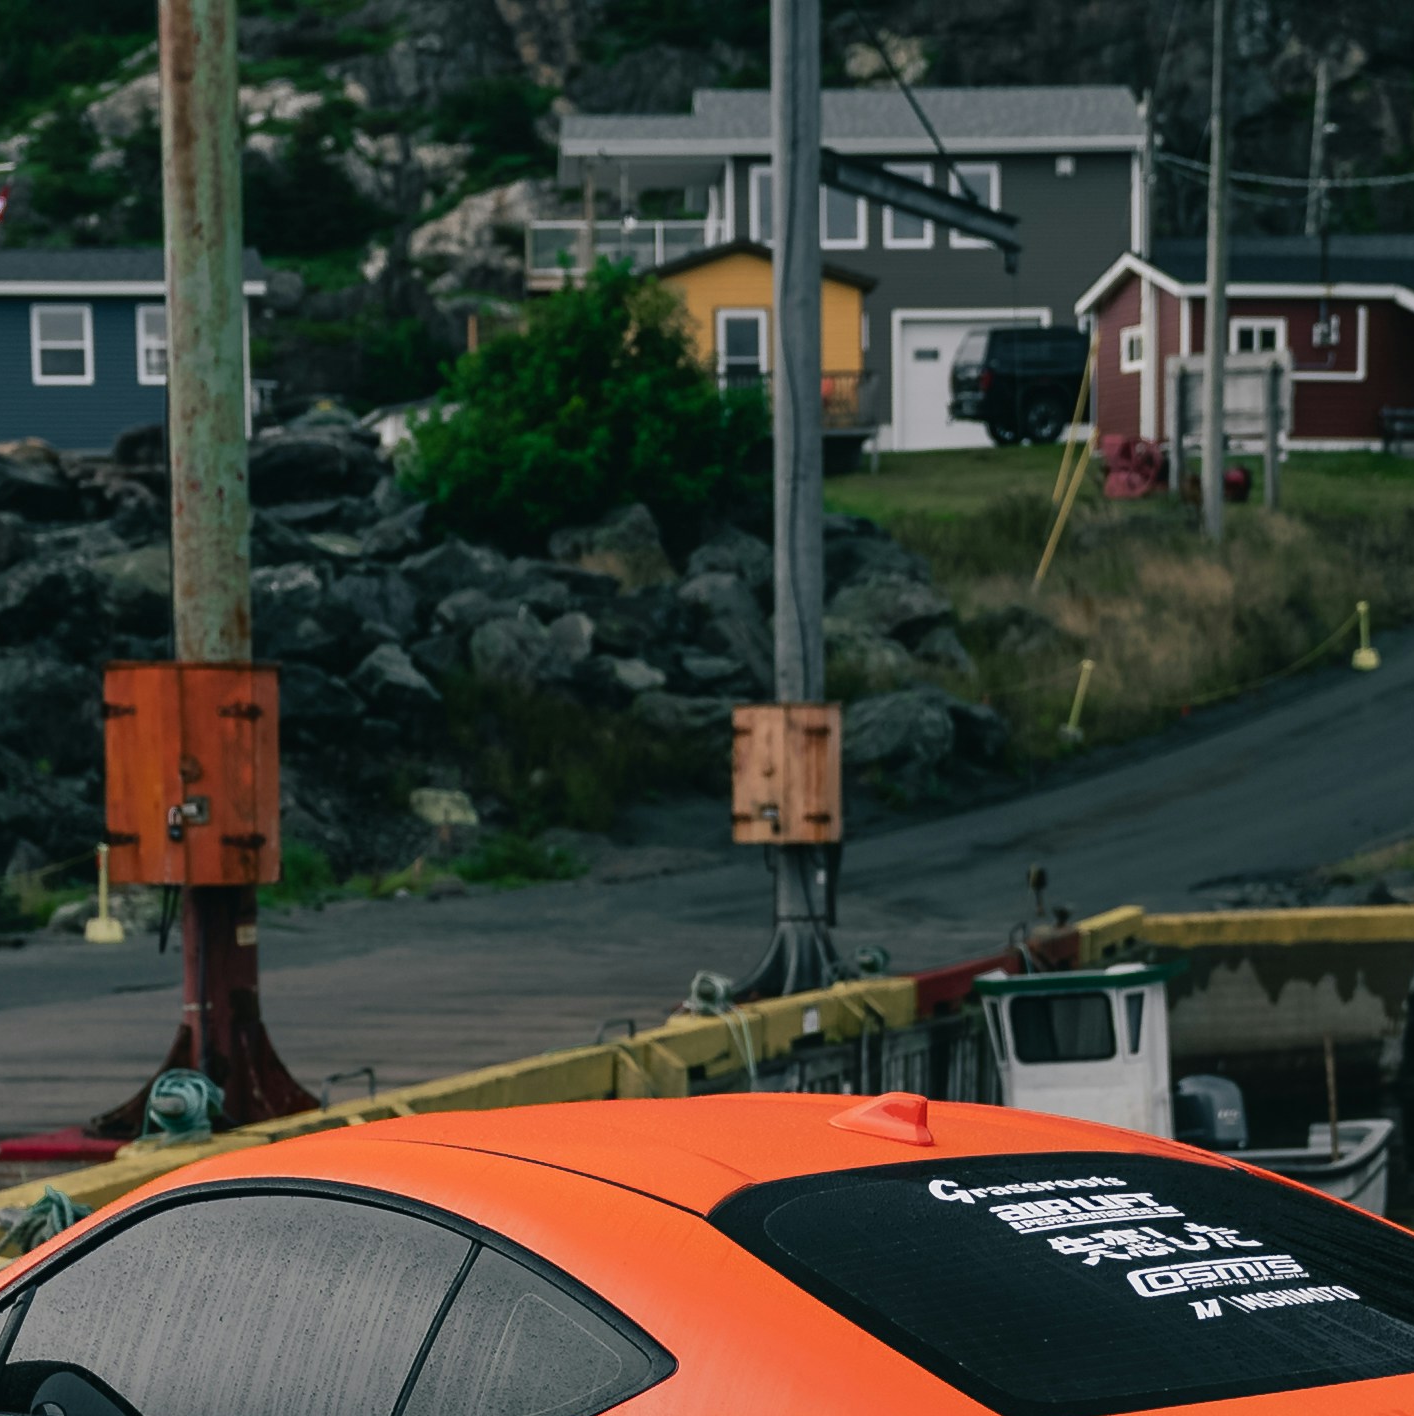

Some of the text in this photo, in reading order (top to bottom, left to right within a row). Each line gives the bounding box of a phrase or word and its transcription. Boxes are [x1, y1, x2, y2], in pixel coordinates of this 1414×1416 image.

[928, 1175, 1128, 1204] Grassroots
[1070, 1192, 1160, 1212] LIFT
[1046, 1222, 1264, 1267] 失恋した
[1191, 1271, 1310, 1291] racing wheels
[1230, 1285, 1361, 1311] MISHIMOTO
